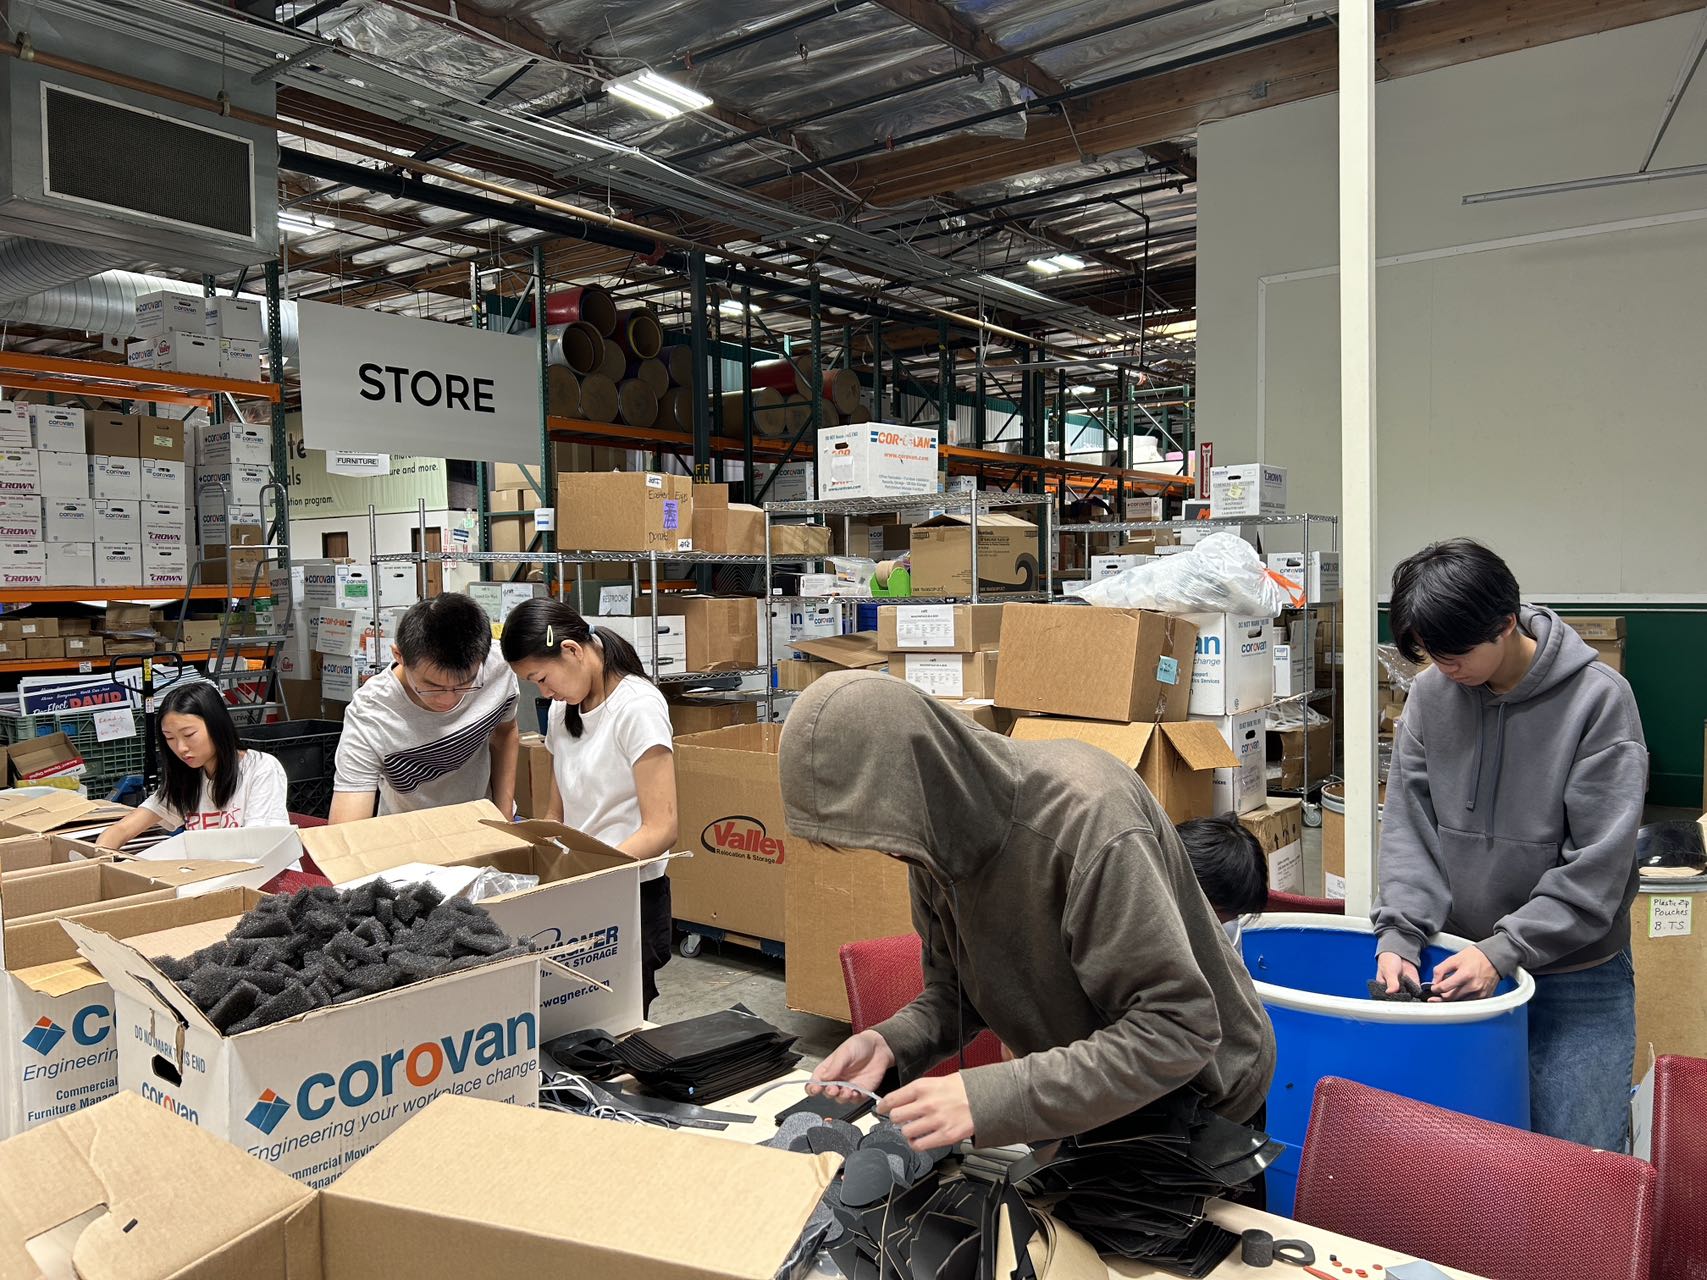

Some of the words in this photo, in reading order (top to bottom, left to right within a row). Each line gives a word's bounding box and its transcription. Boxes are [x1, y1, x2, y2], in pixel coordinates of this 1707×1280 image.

[139, 300, 162, 312] corovan
[173, 305, 196, 313] corovan
[358, 362, 496, 414] STORE
[207, 432, 230, 443] corovan
[337, 457, 377, 465] FURNITURE
[884, 453, 929, 461] www.corovan.com
[402, 462, 416, 474] and
[418, 463, 440, 472] more.
[202, 473, 231, 483] corovan
[1263, 471, 1283, 483] CROWN
[0, 482, 35, 490] CROWN
[304, 495, 334, 507] program.
[149, 533, 181, 541] CROWN
[308, 575, 336, 584] corovan
[603, 593, 629, 603] RESTROOMS
[814, 616, 835, 625] corovan
[1241, 640, 1267, 654] corovan
[1193, 656, 1221, 666] change
[327, 664, 352, 675] corovan
[69, 691, 122, 708] DAVID
[713, 821, 785, 865] Valley
[716, 848, 746, 859] Relocation
[752, 854, 776, 865] Storage
[1653, 898, 1677, 907] Plastic
[1654, 907, 1689, 917] Pouches
[572, 946, 618, 968] STORAGE
[134, 1024, 143, 1041] DO
[155, 1038, 173, 1058] MARK
[173, 1047, 191, 1067] TIS
[191, 1054, 206, 1074] END
[23, 1047, 118, 1082] Engineerin
[296, 1011, 537, 1122] corovan
[56, 1076, 118, 1101] Commercial
[141, 1081, 199, 1126] corovan
[28, 1103, 76, 1122] Furniture
[247, 1116, 355, 1163] Engineering
[359, 1103, 399, 1133] your
[486, 1058, 537, 1087] change
[288, 1154, 342, 1181] mmercial
